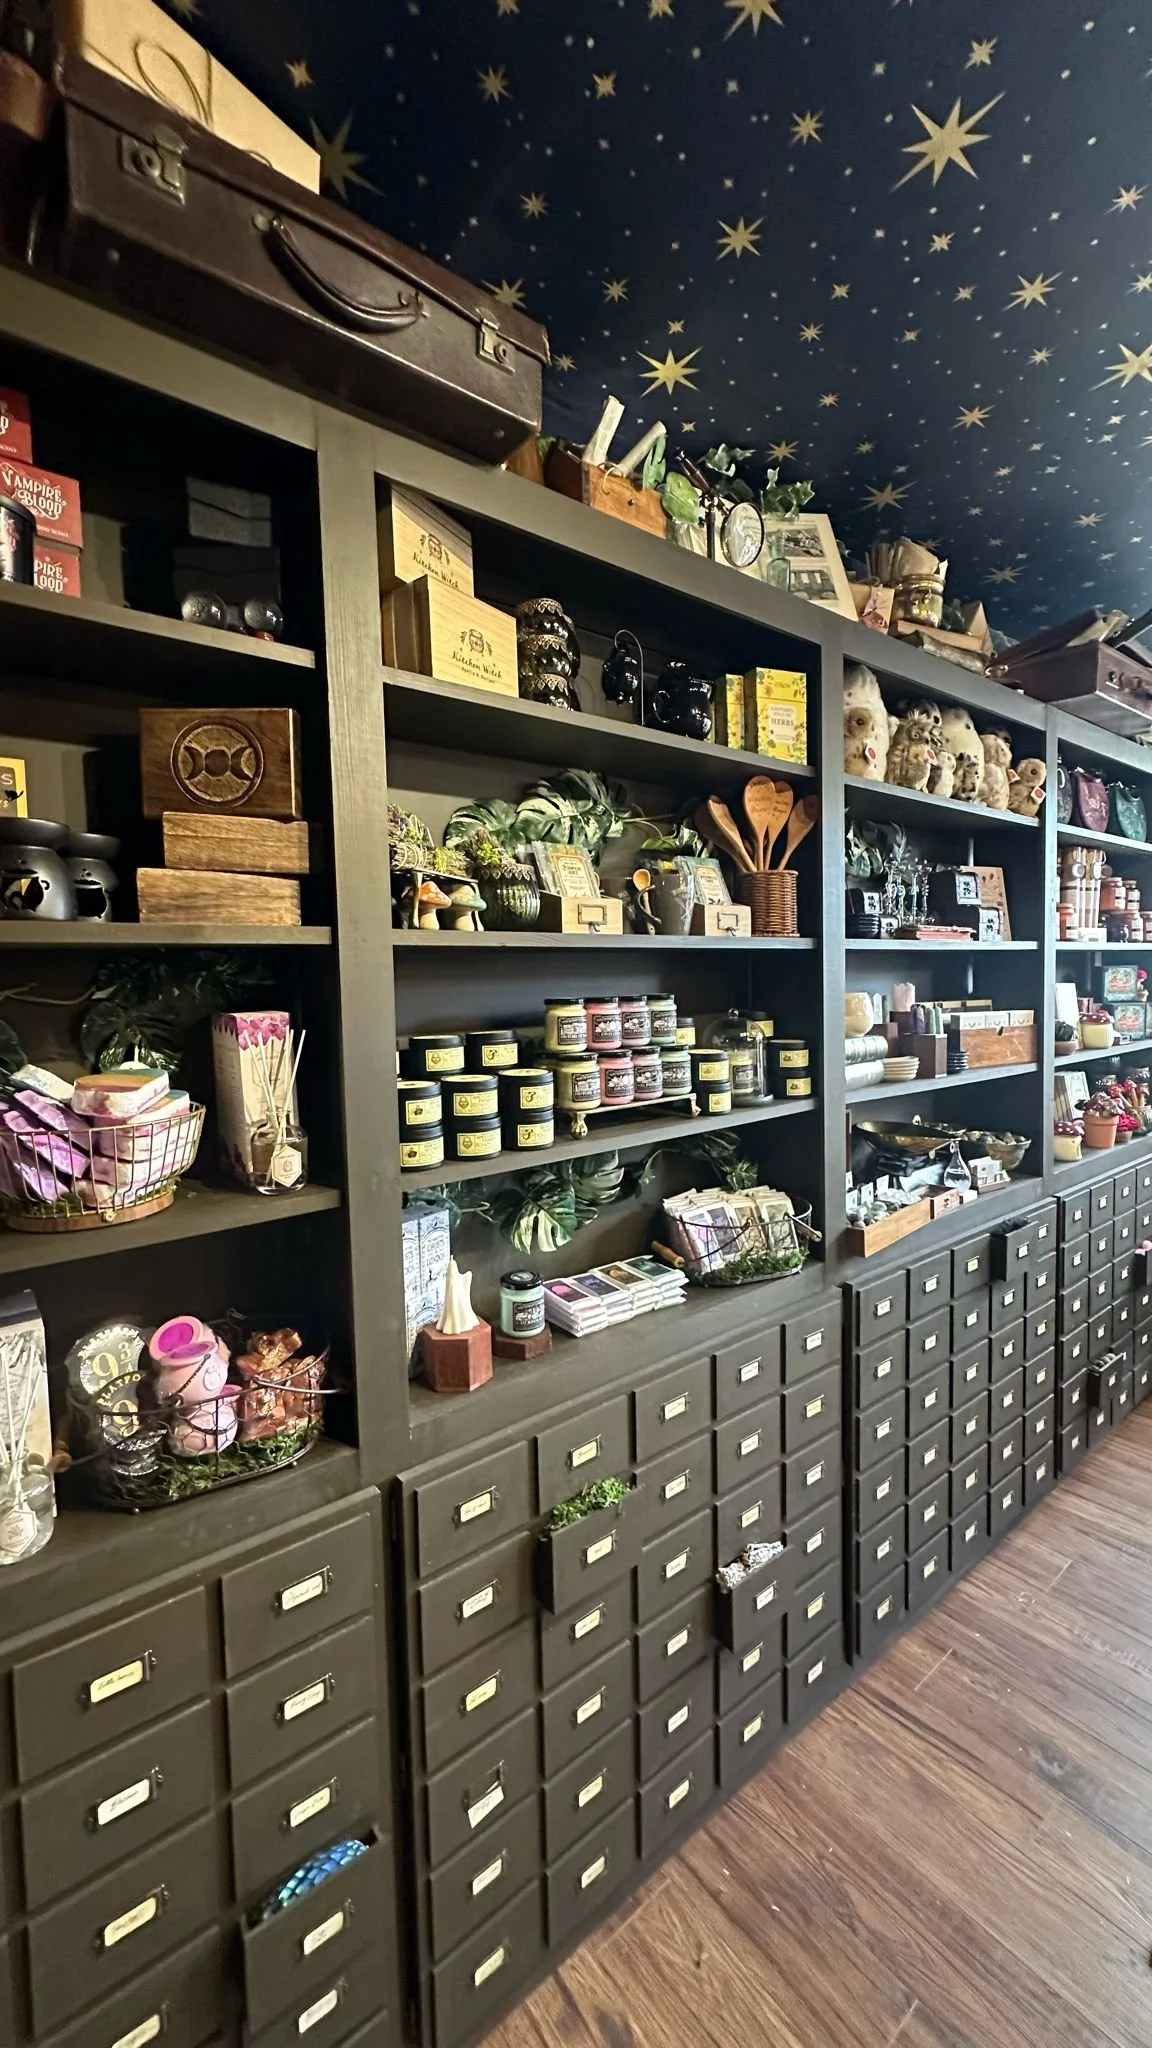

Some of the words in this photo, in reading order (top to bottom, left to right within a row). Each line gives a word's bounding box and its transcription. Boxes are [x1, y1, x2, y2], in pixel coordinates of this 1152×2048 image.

[2, 469, 62, 503] VAMPIRE
[18, 489, 64, 519] BLOOD
[34, 559, 63, 580] PIRE
[34, 573, 64, 594] LOOD
[413, 552, 439, 577] Kitchen
[441, 571, 459, 588] Witch
[452, 651, 481, 672] Kitchen
[482, 664, 502, 679] Witch
